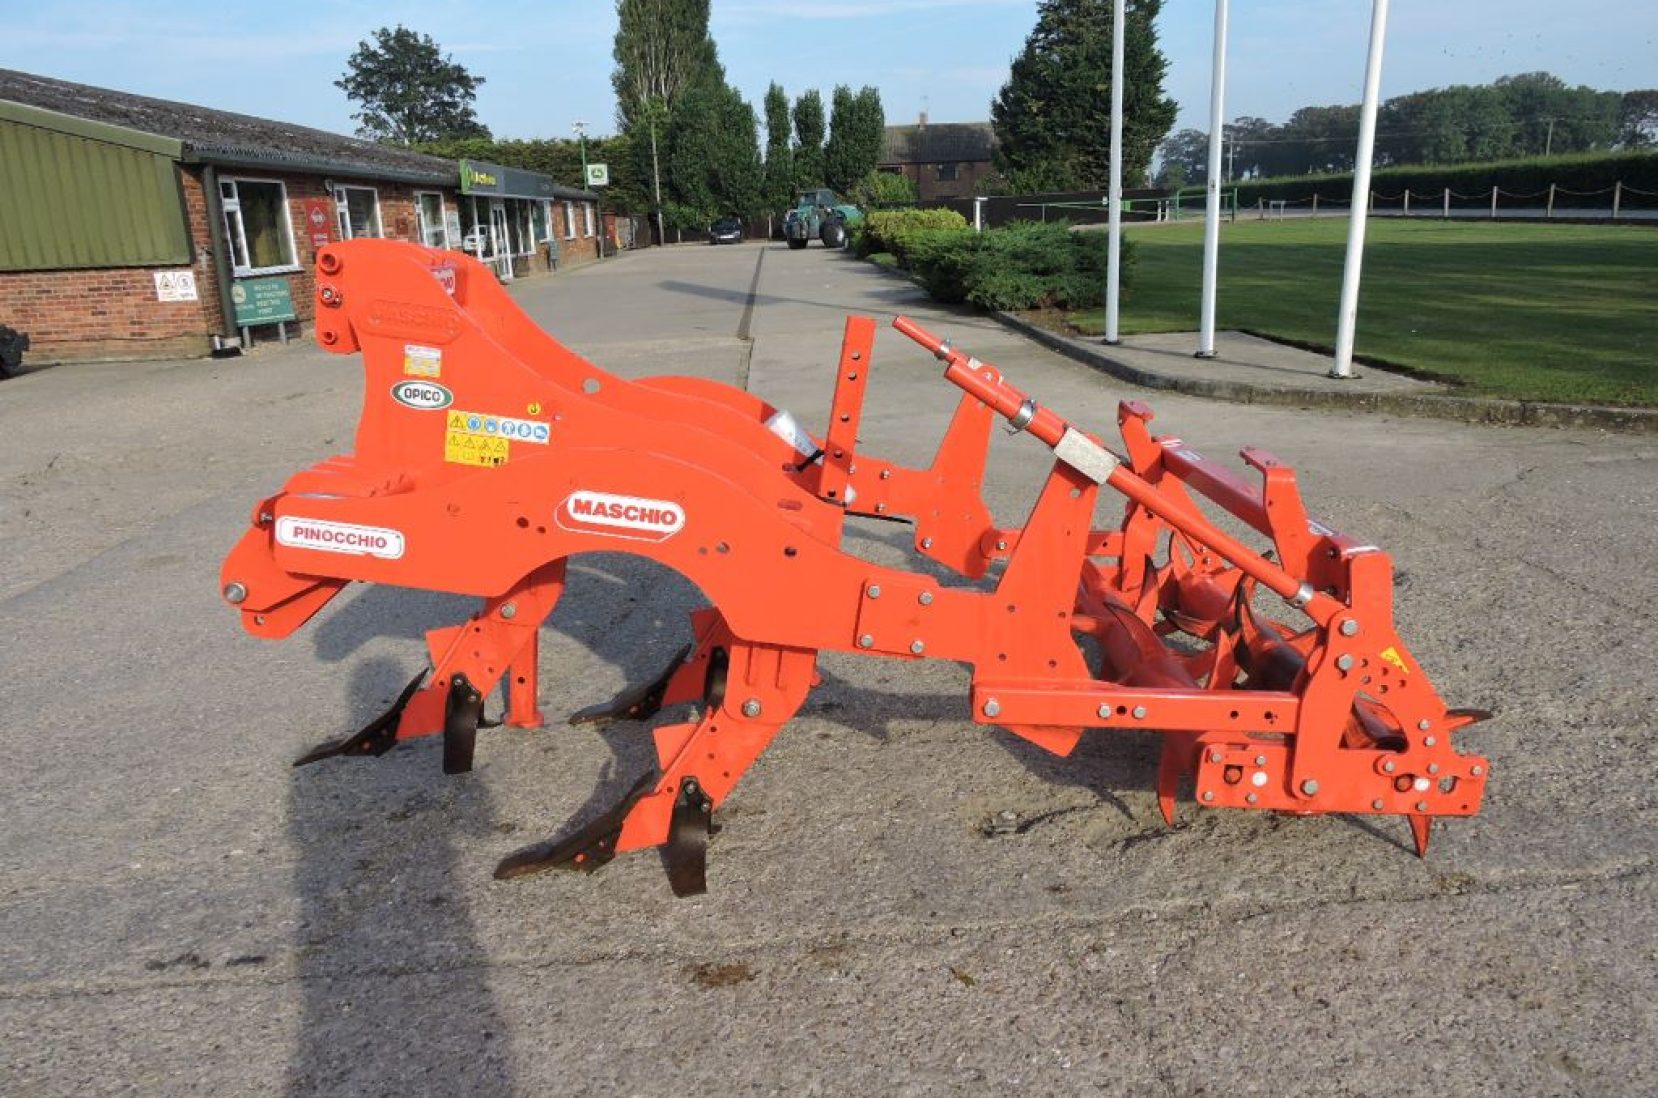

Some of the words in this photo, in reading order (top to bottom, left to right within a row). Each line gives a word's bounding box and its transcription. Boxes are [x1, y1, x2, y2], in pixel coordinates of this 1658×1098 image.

[404, 387, 441, 402] OPICO
[573, 498, 677, 526] MASCHIO
[293, 526, 387, 548] PINOCCHIO
